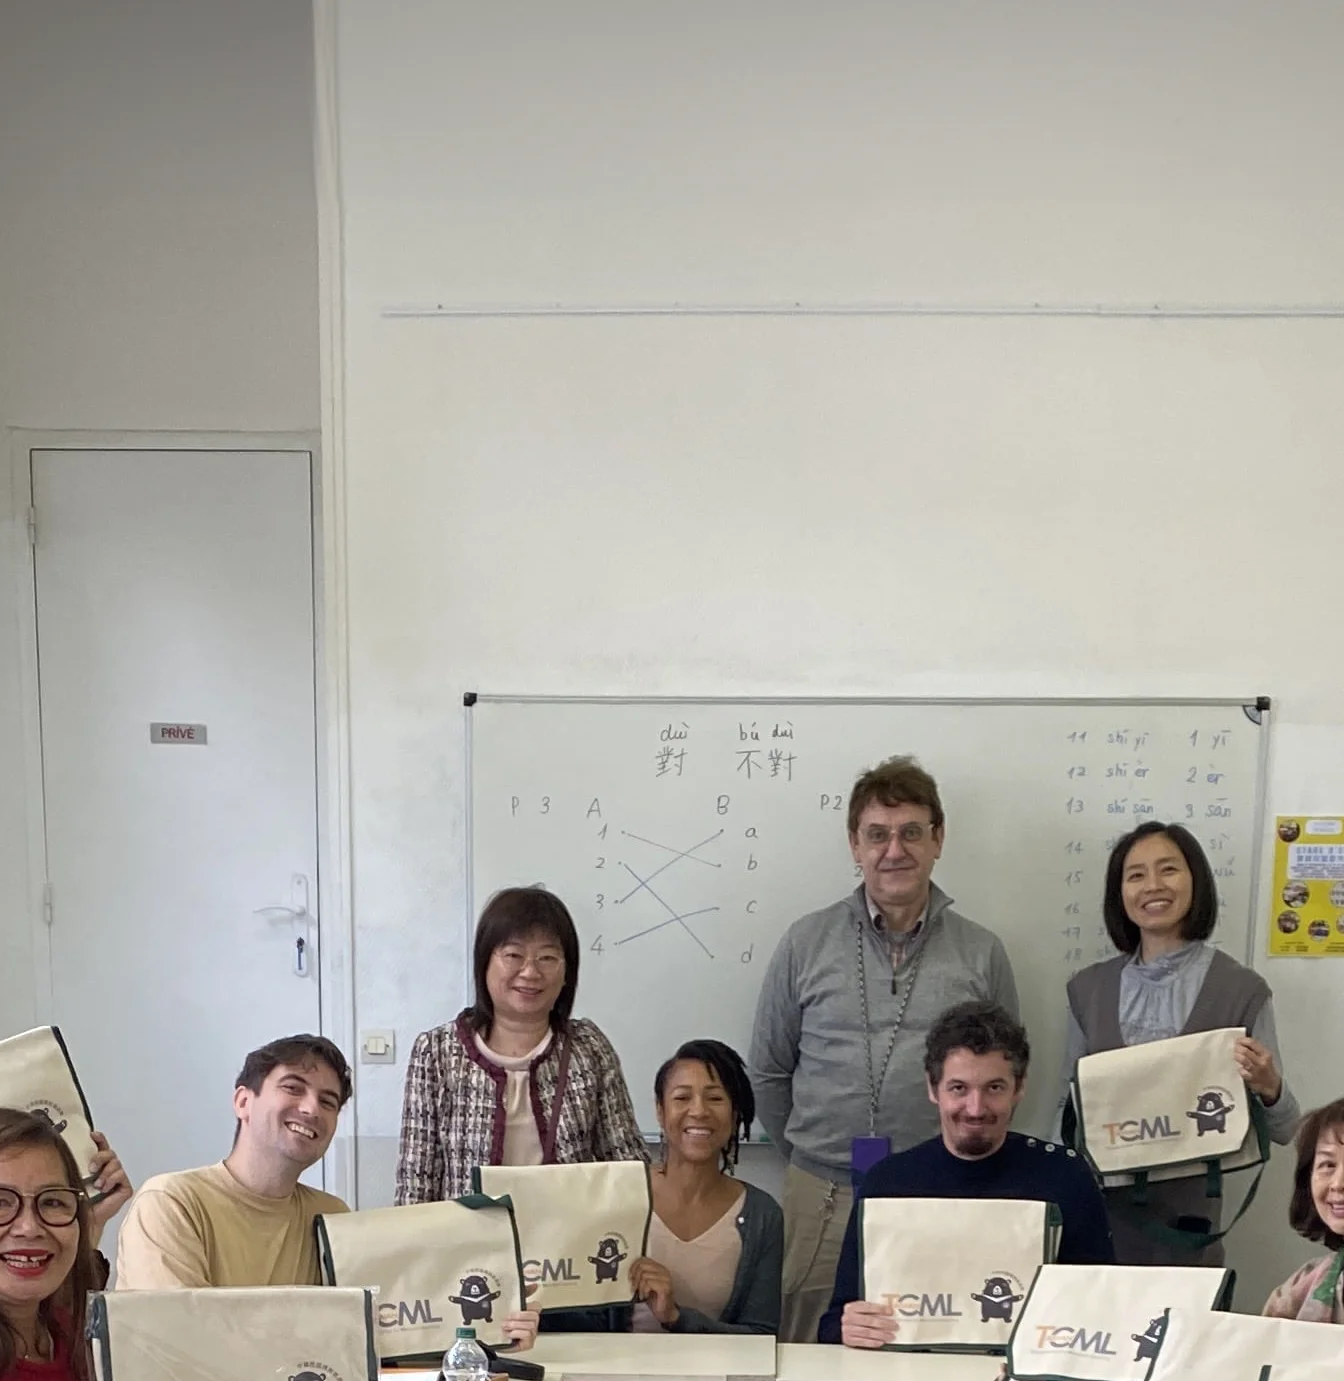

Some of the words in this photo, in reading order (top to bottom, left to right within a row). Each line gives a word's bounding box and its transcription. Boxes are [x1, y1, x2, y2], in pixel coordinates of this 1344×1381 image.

[656, 746, 688, 777] 對
[736, 749, 797, 782] 不對
[1186, 767, 1197, 783] 2
[540, 796, 550, 815] 3
[586, 797, 602, 818] A
[717, 794, 730, 816] B
[745, 826, 758, 838] a
[595, 856, 606, 869] 2
[747, 854, 758, 870] b
[595, 894, 604, 909] 3
[590, 939, 603, 956] 4
[741, 944, 753, 963] d
[1102, 1115, 1181, 1144] TCML
[522, 1258, 581, 1282] CML
[378, 1300, 443, 1328] CML
[881, 1292, 962, 1317] TCML
[1036, 1325, 1117, 1355] TCML
